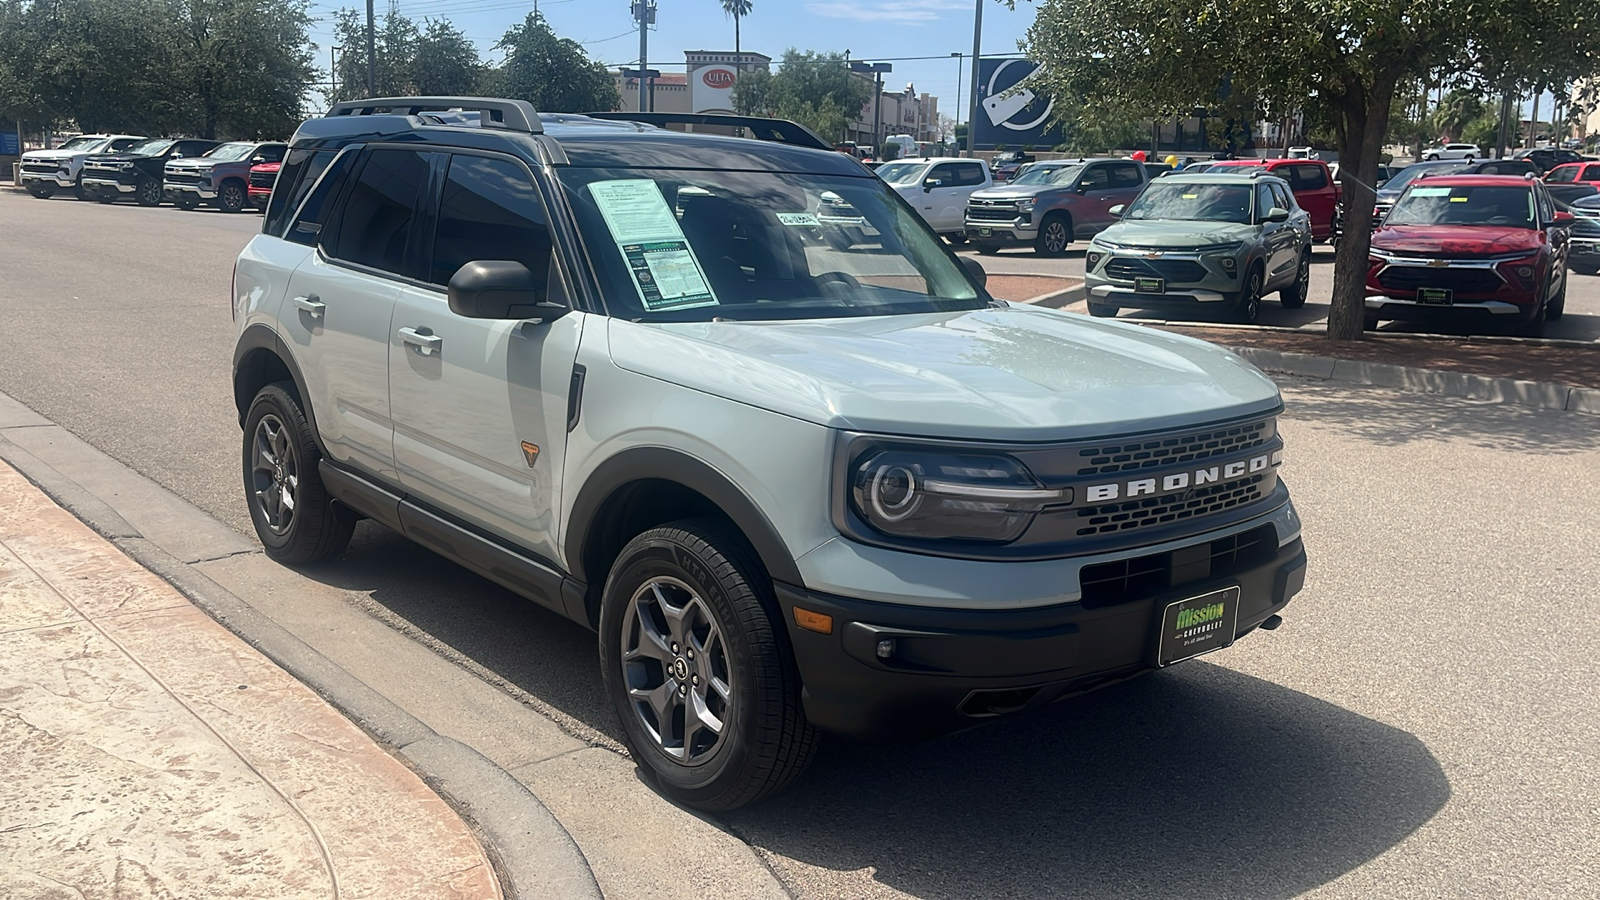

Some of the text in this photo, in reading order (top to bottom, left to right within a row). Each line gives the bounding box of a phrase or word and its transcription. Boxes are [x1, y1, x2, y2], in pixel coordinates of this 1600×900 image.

[708, 73, 732, 82] ULTA
[1087, 455, 1268, 502] BRONCO
[682, 555, 707, 586] HTR
[1176, 602, 1225, 630] Mission
[1183, 620, 1223, 638] CHEVROLET
